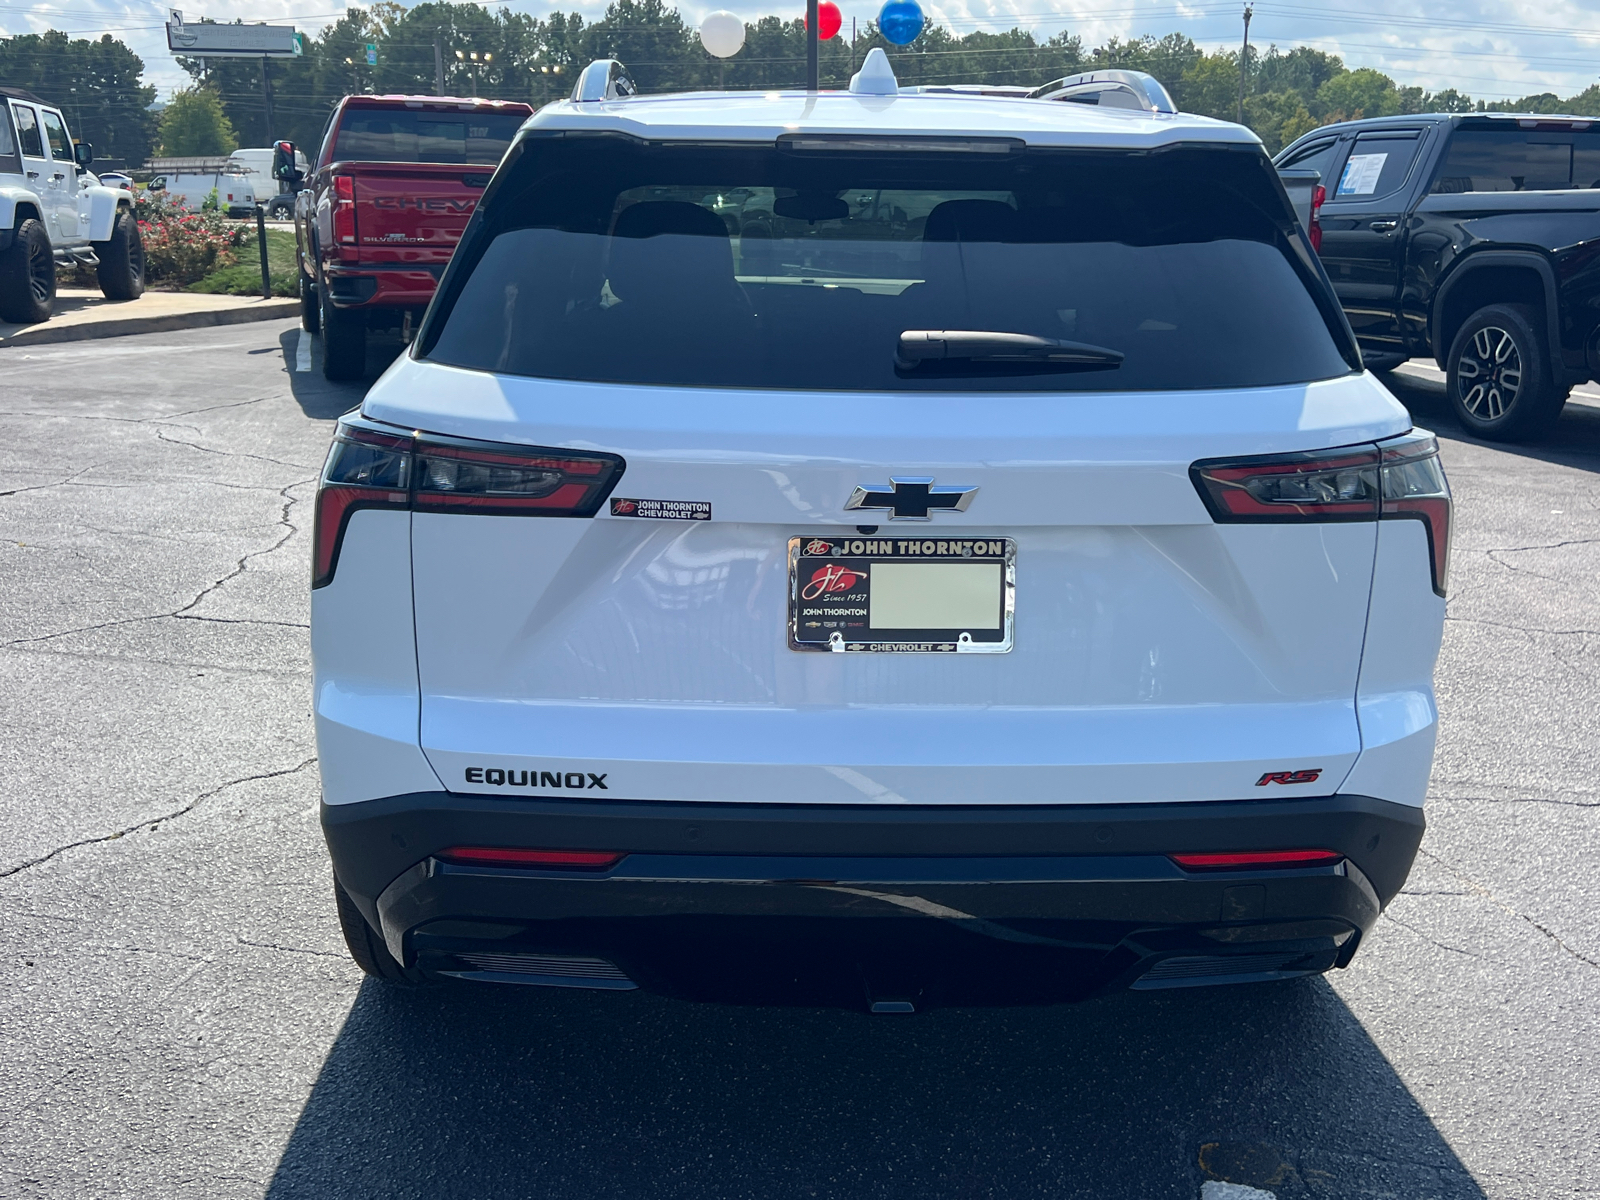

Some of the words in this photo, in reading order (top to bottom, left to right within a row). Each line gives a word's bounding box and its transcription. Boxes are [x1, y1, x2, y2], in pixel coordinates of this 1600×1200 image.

[638, 501, 661, 510] JOHN
[662, 502, 709, 512] THORNTON
[638, 509, 692, 519] CHEVROLET
[841, 541, 892, 554] JOHN
[898, 541, 1002, 555] THORNTON
[823, 594, 846, 602] Since
[847, 593, 867, 602] 1957
[802, 608, 823, 616] JOHN
[823, 608, 867, 616] THORNTON
[870, 643, 933, 651] CHEVROLET
[465, 767, 608, 789] EQUINOX
[1255, 768, 1323, 786] RS
